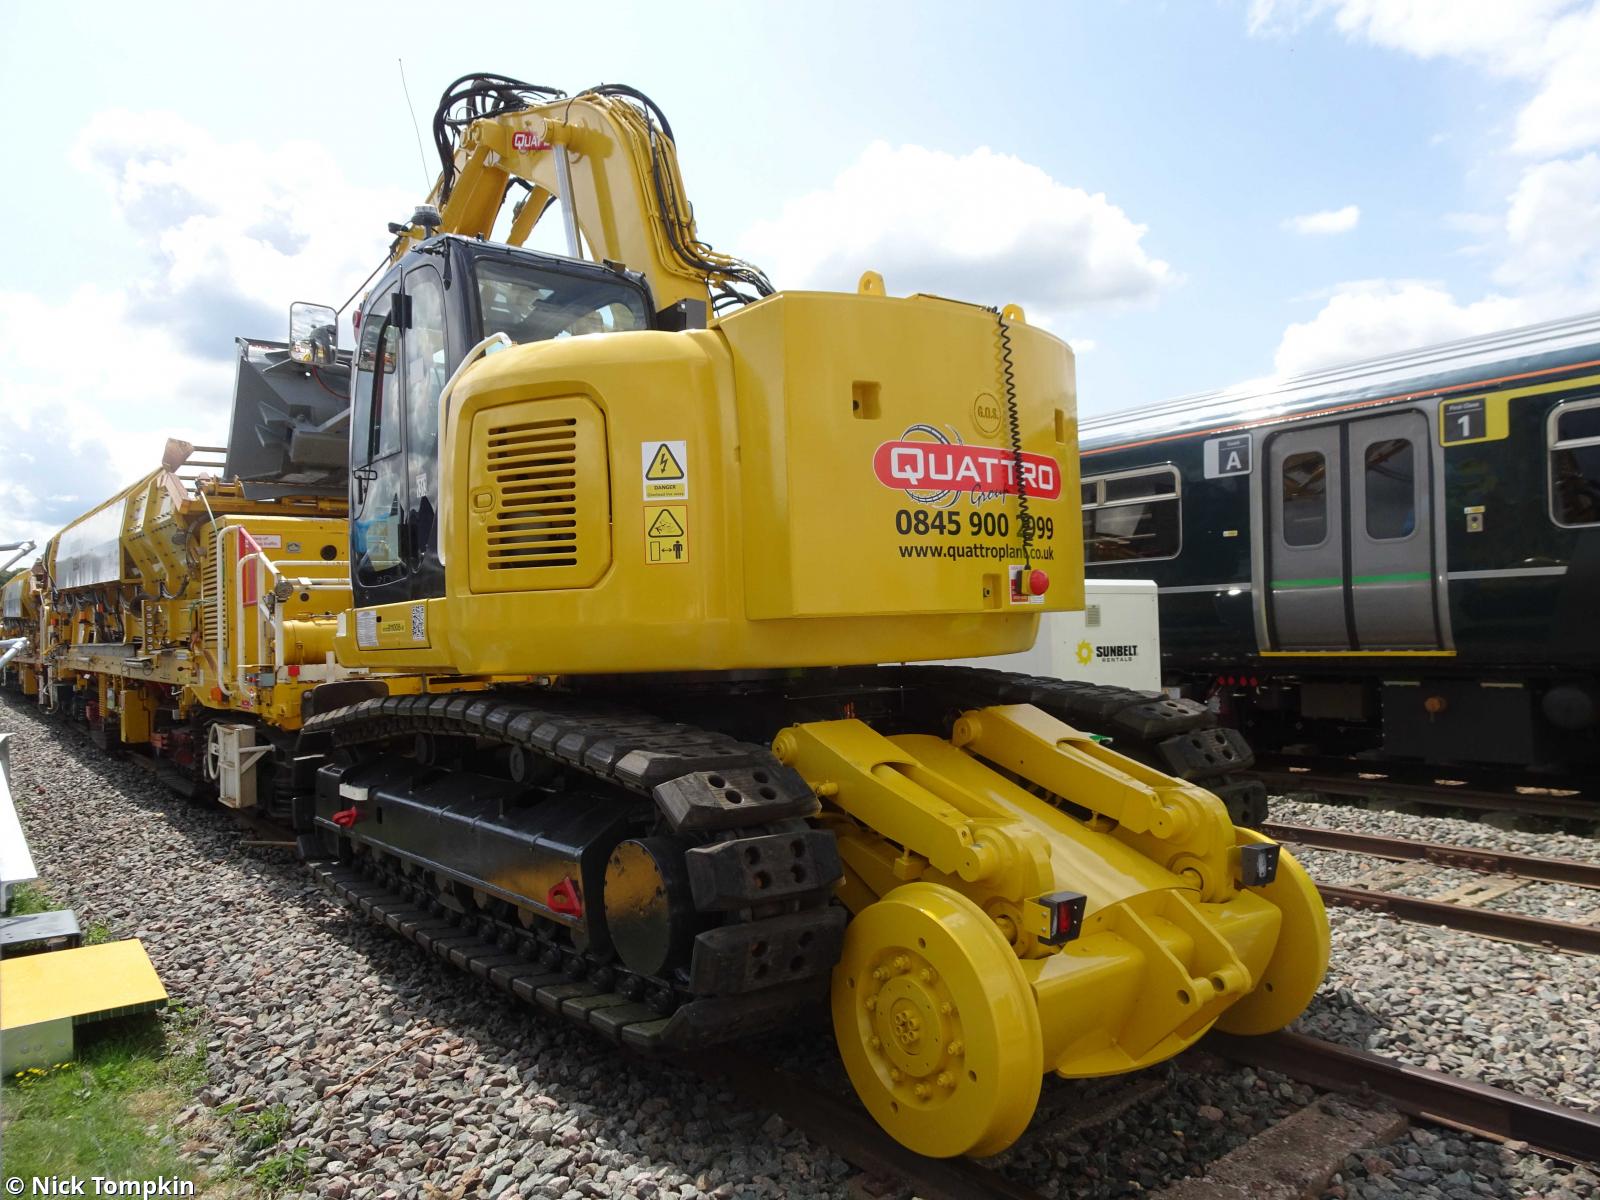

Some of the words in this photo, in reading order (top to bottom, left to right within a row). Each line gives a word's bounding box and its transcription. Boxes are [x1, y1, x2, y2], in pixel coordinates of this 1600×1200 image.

[1457, 415, 1470, 437] 1
[891, 447, 1054, 490] QUATTRO
[1226, 451, 1242, 470] A
[896, 509, 961, 535] 0845
[969, 512, 1009, 537] 900
[1096, 645, 1138, 657] SUNBELT
